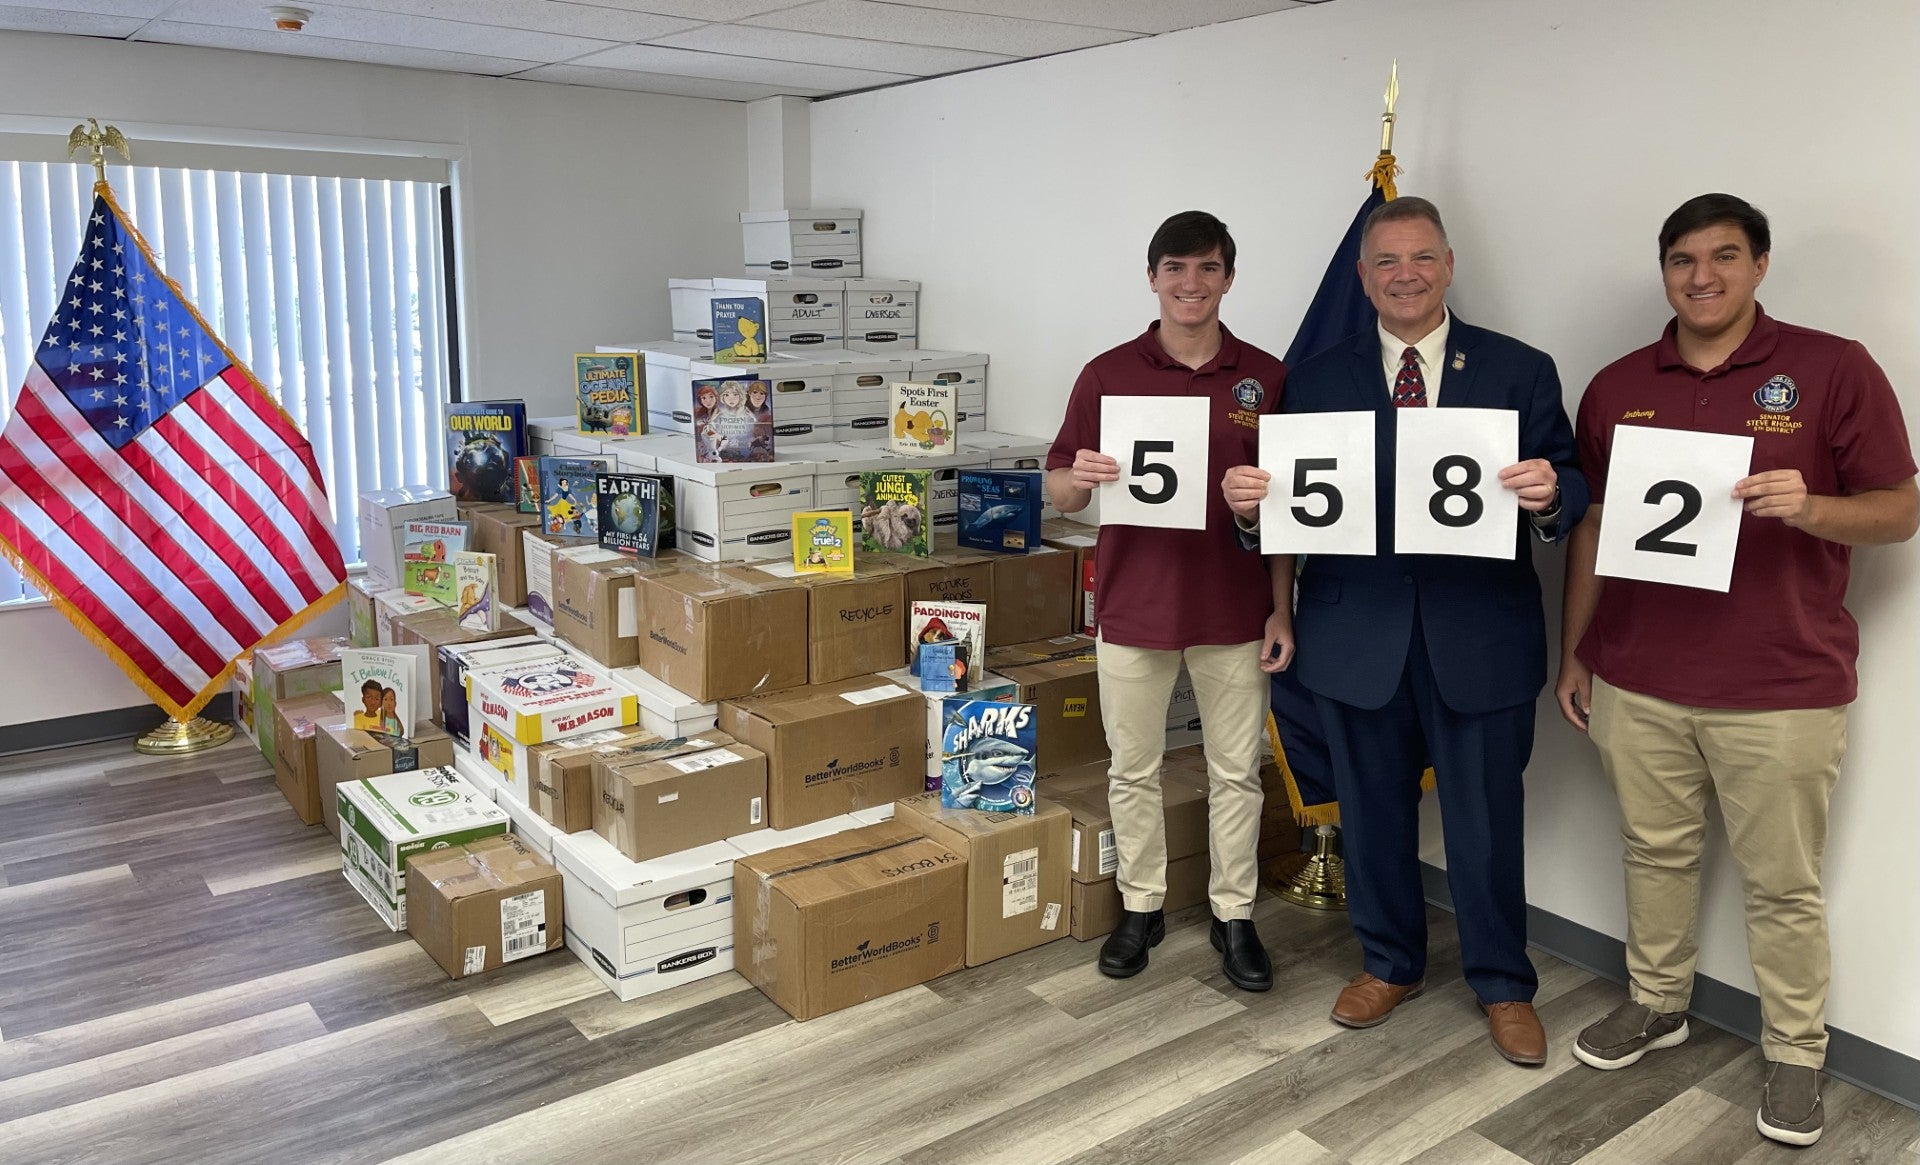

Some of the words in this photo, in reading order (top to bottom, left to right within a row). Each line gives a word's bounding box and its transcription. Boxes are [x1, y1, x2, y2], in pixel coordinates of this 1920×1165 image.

[715, 302, 733, 310] THANK
[791, 308, 826, 319] ADULT
[865, 309, 902, 319] OVERSEAS
[584, 369, 627, 381] ULTIMATE
[580, 378, 634, 394] OCEAN-
[900, 386, 925, 398] Spot's
[926, 387, 948, 398] First
[589, 389, 631, 405] PEDIA
[909, 397, 939, 408] Easter
[1228, 412, 1244, 420] STEVE
[1622, 407, 1655, 420] Anthony
[450, 415, 474, 431] OUR
[474, 415, 513, 431] WORLD
[1771, 420, 1803, 429] RHOADS
[1766, 426, 1795, 434] DISTRICT
[1128, 440, 1178, 504] 5
[881, 475, 905, 483] CUTEST
[961, 475, 993, 485] PROWLING
[598, 478, 655, 500] EARTH!
[875, 482, 913, 494] JUNGLE
[981, 485, 1000, 494] SEAS
[1290, 458, 1344, 527] 5
[1428, 455, 1484, 527] 8
[876, 492, 905, 501] ANIMALS
[1634, 479, 1703, 557] 2
[409, 524, 423, 533] BIG
[425, 525, 440, 534] RED
[441, 526, 461, 536] BARN
[809, 524, 837, 535] weird
[603, 536, 631, 547] BILLION
[632, 540, 650, 551] YEARS
[616, 532, 631, 540] FIRST
[632, 533, 648, 543] 4.54
[749, 534, 777, 542] BANKERS
[812, 536, 835, 546] true!
[834, 538, 841, 547] 2
[929, 577, 970, 593] PICTURE
[942, 589, 973, 600] BOOKS
[839, 604, 896, 622] RECYCLE
[913, 607, 980, 621] PADDINGTON
[350, 671, 360, 684] I
[359, 666, 387, 680] Believe
[392, 673, 404, 692] Can
[1064, 702, 1085, 712] HEAVY
[953, 706, 1032, 753] SHARKS
[804, 757, 885, 783] BetterWorldBooks
[933, 852, 958, 864] 39
[881, 859, 935, 878] BOOKS
[831, 935, 922, 969] BetterWorldBooks
[660, 955, 694, 972] BANKERS
[695, 949, 714, 961] BOX
